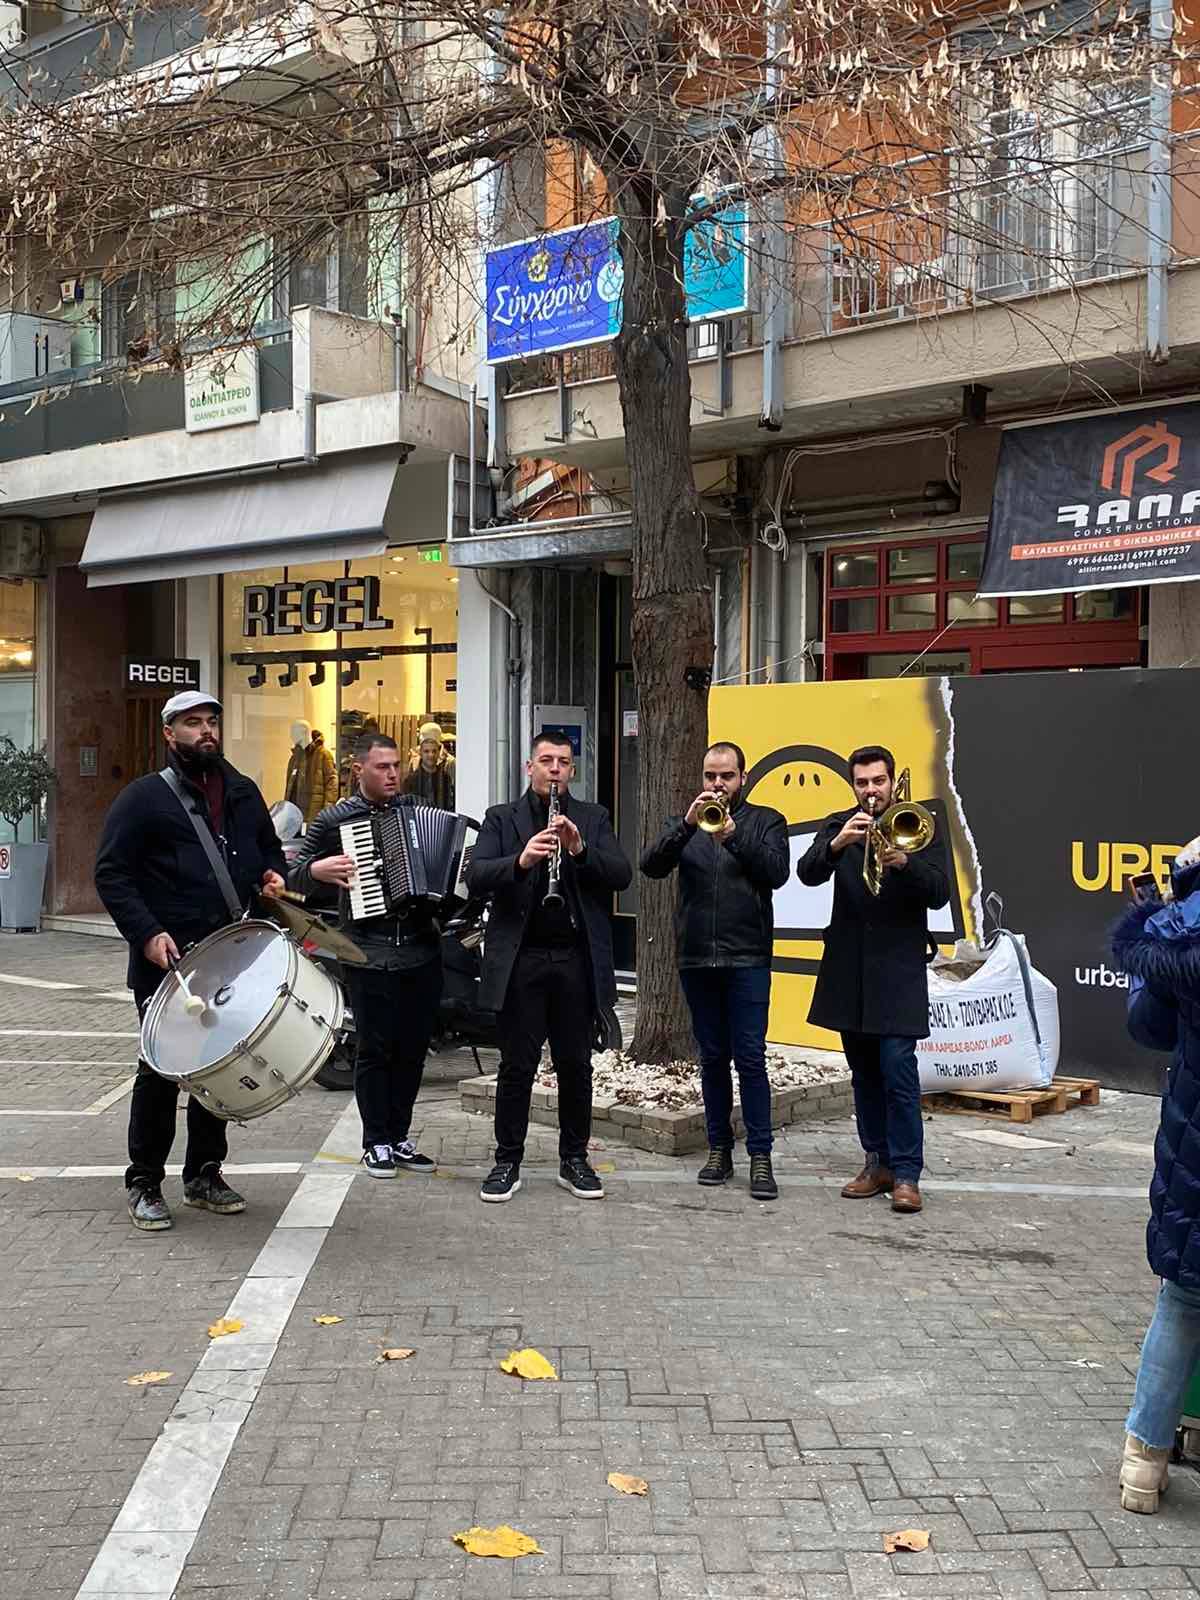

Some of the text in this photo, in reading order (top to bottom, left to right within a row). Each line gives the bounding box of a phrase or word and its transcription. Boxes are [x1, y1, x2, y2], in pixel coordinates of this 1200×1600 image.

[1073, 516, 1193, 537] CONSTRUCTION
[1123, 531, 1193, 546] ΟΙΚΟΔΟΜΙΚΕΣ
[1132, 549, 1155, 560] 6977
[243, 576, 393, 636] REGEL
[129, 663, 197, 684] REGEL
[953, 1062, 984, 1078] 2410-571
[985, 1059, 998, 1074] 385
